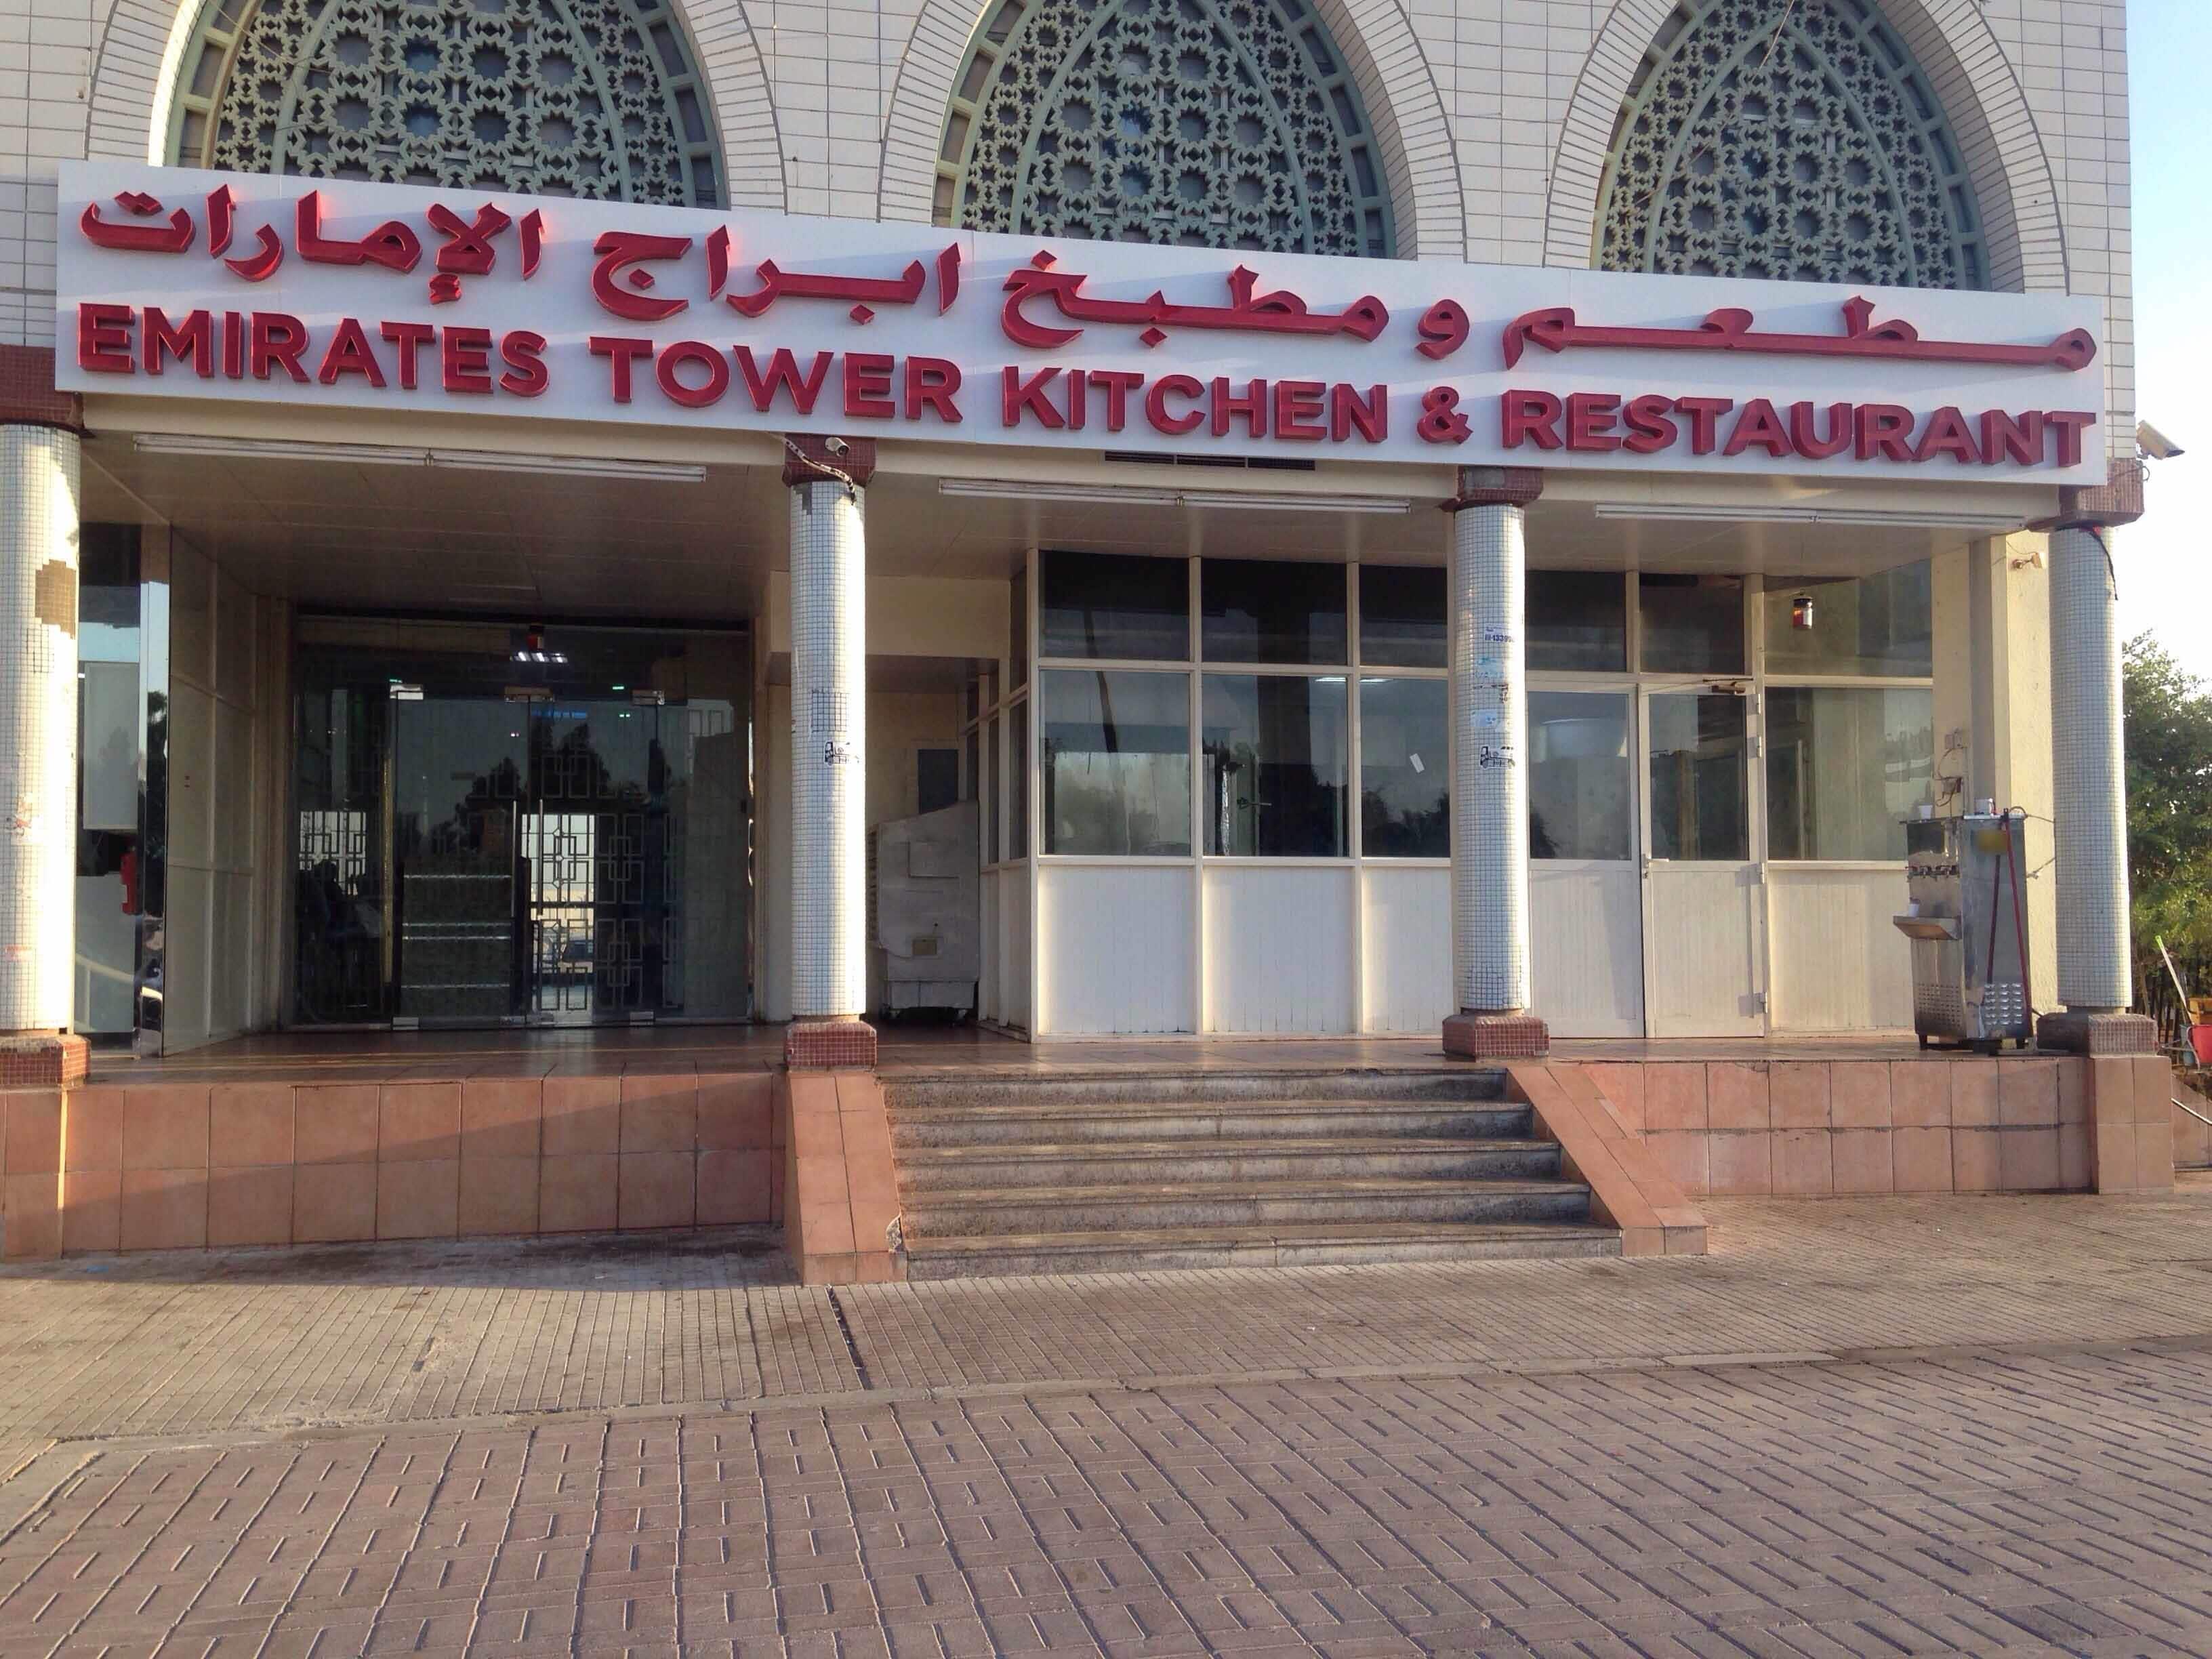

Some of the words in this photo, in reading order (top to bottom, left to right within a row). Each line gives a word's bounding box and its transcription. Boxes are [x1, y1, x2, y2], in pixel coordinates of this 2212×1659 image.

[1001, 249, 1389, 348] مطبخ
[1415, 298, 1470, 360] و
[1502, 295, 2097, 371] مطعم
[77, 302, 550, 398] EMIRATES
[588, 335, 964, 424] TOWER
[1002, 365, 1389, 443] KITCHEN
[1416, 386, 1473, 444] &
[1502, 389, 2097, 468] RESTAURANT
